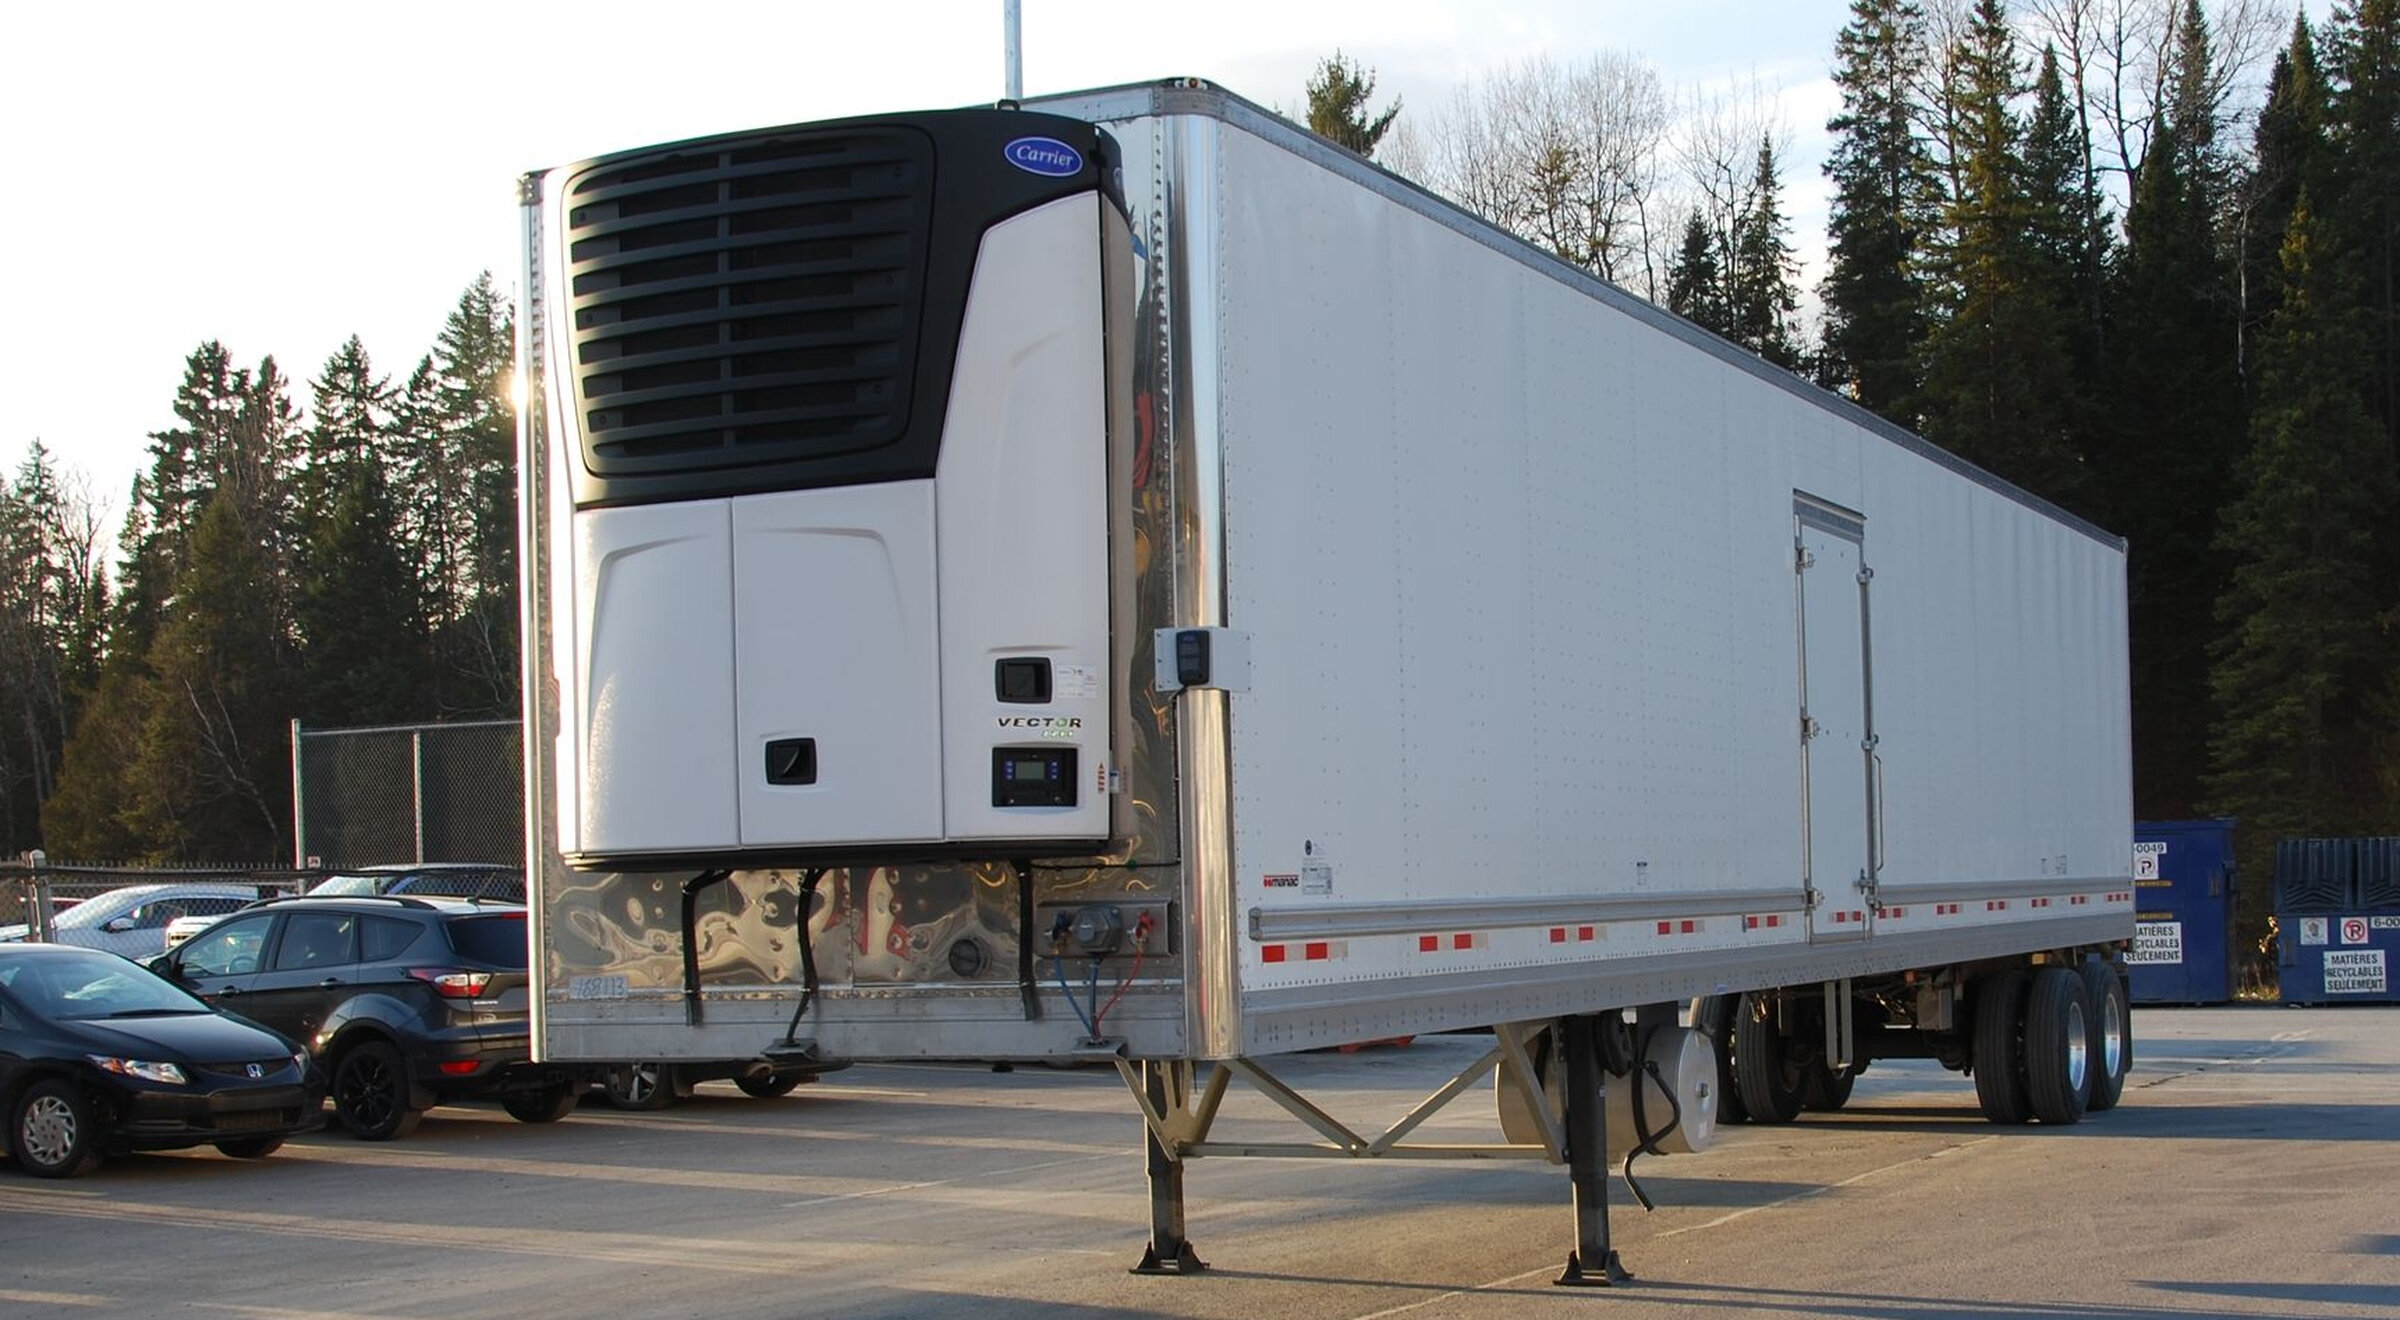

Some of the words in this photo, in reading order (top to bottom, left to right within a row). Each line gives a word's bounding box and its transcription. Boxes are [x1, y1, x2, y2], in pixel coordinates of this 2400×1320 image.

[1016, 145, 1073, 166] Carrier
[998, 717, 1081, 728] VECTOR
[2136, 924, 2173, 936] ATIÈRES
[2126, 951, 2180, 961] SEULEMENT
[2327, 979, 2383, 990] SEULEMENT
